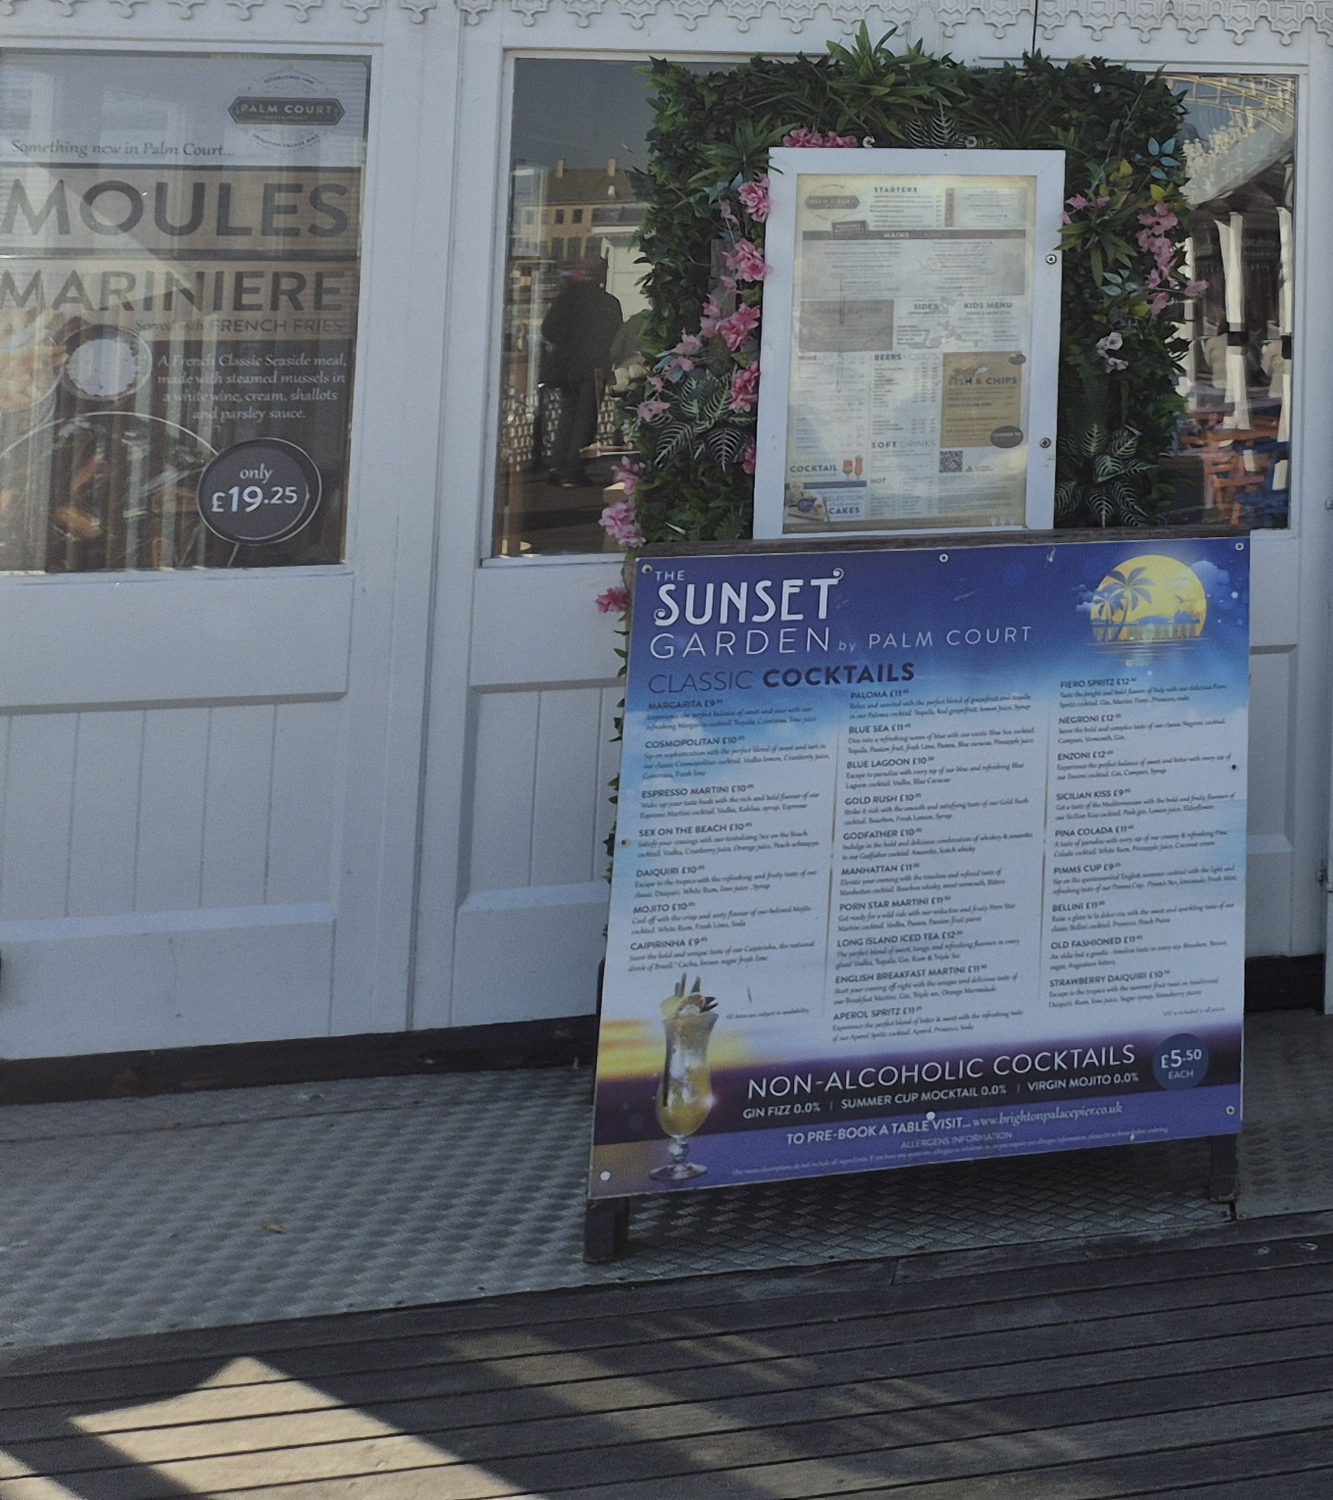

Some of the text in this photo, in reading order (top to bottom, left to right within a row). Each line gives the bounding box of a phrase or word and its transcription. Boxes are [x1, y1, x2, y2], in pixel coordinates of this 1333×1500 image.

[240, 104, 334, 114] PALM COURT
[12, 138, 88, 158] Something
[92, 144, 123, 155] new
[125, 142, 139, 154] in
[143, 142, 179, 155] Palm
[0, 179, 349, 237] MOULES
[883, 231, 910, 239] MAINS
[0, 269, 345, 312] MARINIERE
[913, 303, 938, 311] SIDES
[963, 301, 1012, 310] KIDS MENU
[211, 318, 287, 333] FRENCH
[293, 318, 343, 332] FRIES
[219, 353, 263, 367] Classic
[265, 353, 311, 367] Seaside
[313, 353, 347, 368] meal,
[225, 371, 277, 384] steamed
[280, 371, 331, 384] mussels
[332, 371, 346, 383] in
[948, 377, 972, 386] FISH
[986, 377, 1018, 385] CHIPS
[244, 392, 287, 403] cream,
[290, 388, 338, 401] shallots
[220, 407, 267, 424] parsley
[269, 409, 306, 420] sauce.
[871, 440, 937, 449] SOFT DRINKS
[240, 463, 273, 484] only
[790, 465, 839, 473] COCKTAIL
[211, 485, 298, 513] £19.25
[829, 507, 860, 515] CAKES
[655, 570, 685, 581] THE
[654, 568, 844, 626] SUNSET
[650, 626, 1031, 659] GARDEN by PALM COURT
[648, 662, 915, 694] CLASSIC COCKTAILS
[1060, 678, 1115, 689] FIERO SPRITZ
[850, 691, 887, 700] PALOMA
[648, 700, 701, 711] MARGARITA
[1058, 715, 1099, 725] NEGRONI
[849, 725, 871, 734] BLUE
[873, 724, 889, 733] SEA
[645, 737, 720, 749] COSMOPOLITAN
[1057, 751, 1091, 761] ENZONI
[847, 758, 910, 769] BLUE LAGOON
[642, 786, 729, 799] ESPRESSO MARTINI
[1056, 789, 1112, 800] SICILIAN KISS
[845, 795, 897, 806] GOLD RUSH
[639, 824, 727, 837] SEX ON THE BEACH
[843, 830, 898, 841] GODFATHER
[1055, 829, 1076, 837] PINA
[1077, 826, 1113, 836] COLADA
[636, 867, 679, 878] DAIQUIRI
[841, 865, 898, 876] MANHATTAN
[1053, 863, 1102, 875] PIMMS CUP
[633, 904, 670, 914] MOJITO
[839, 898, 929, 911] PORN STAR MARTINI
[1052, 903, 1084, 912] BELLINI
[630, 938, 686, 951] CAIPIRINHA
[837, 932, 939, 947] LONG ISLAND ICED TEA
[1050, 937, 1122, 950] OLD FASHIONED
[835, 966, 966, 984] ENGLISH BREAKFAST MARTINI
[1050, 972, 1147, 987] STRAWBERRY DAIQUIRI
[833, 1008, 900, 1021] APEROL SPRITZ
[1161, 1049, 1202, 1069] £5.50
[748, 1044, 1136, 1099] NON-ALCOHOLIC COCKTAILS
[1168, 1069, 1194, 1080] EACH
[743, 1072, 1139, 1119] GIN FIZZ 0.0% SUMMER CUP MOCKTAIL 0.0% VIRGIN MOJITO 0.0%
[786, 1133, 804, 1146] TO
[807, 1125, 876, 1143] PRE-BOOK
[878, 1123, 890, 1135] A
[891, 1120, 929, 1133] TABLE
[972, 1101, 1123, 1128] www.brightonpalacepier.co.uk
[901, 1136, 950, 1149] ALLERGENS
[952, 1131, 1012, 1146] INFORMATION
